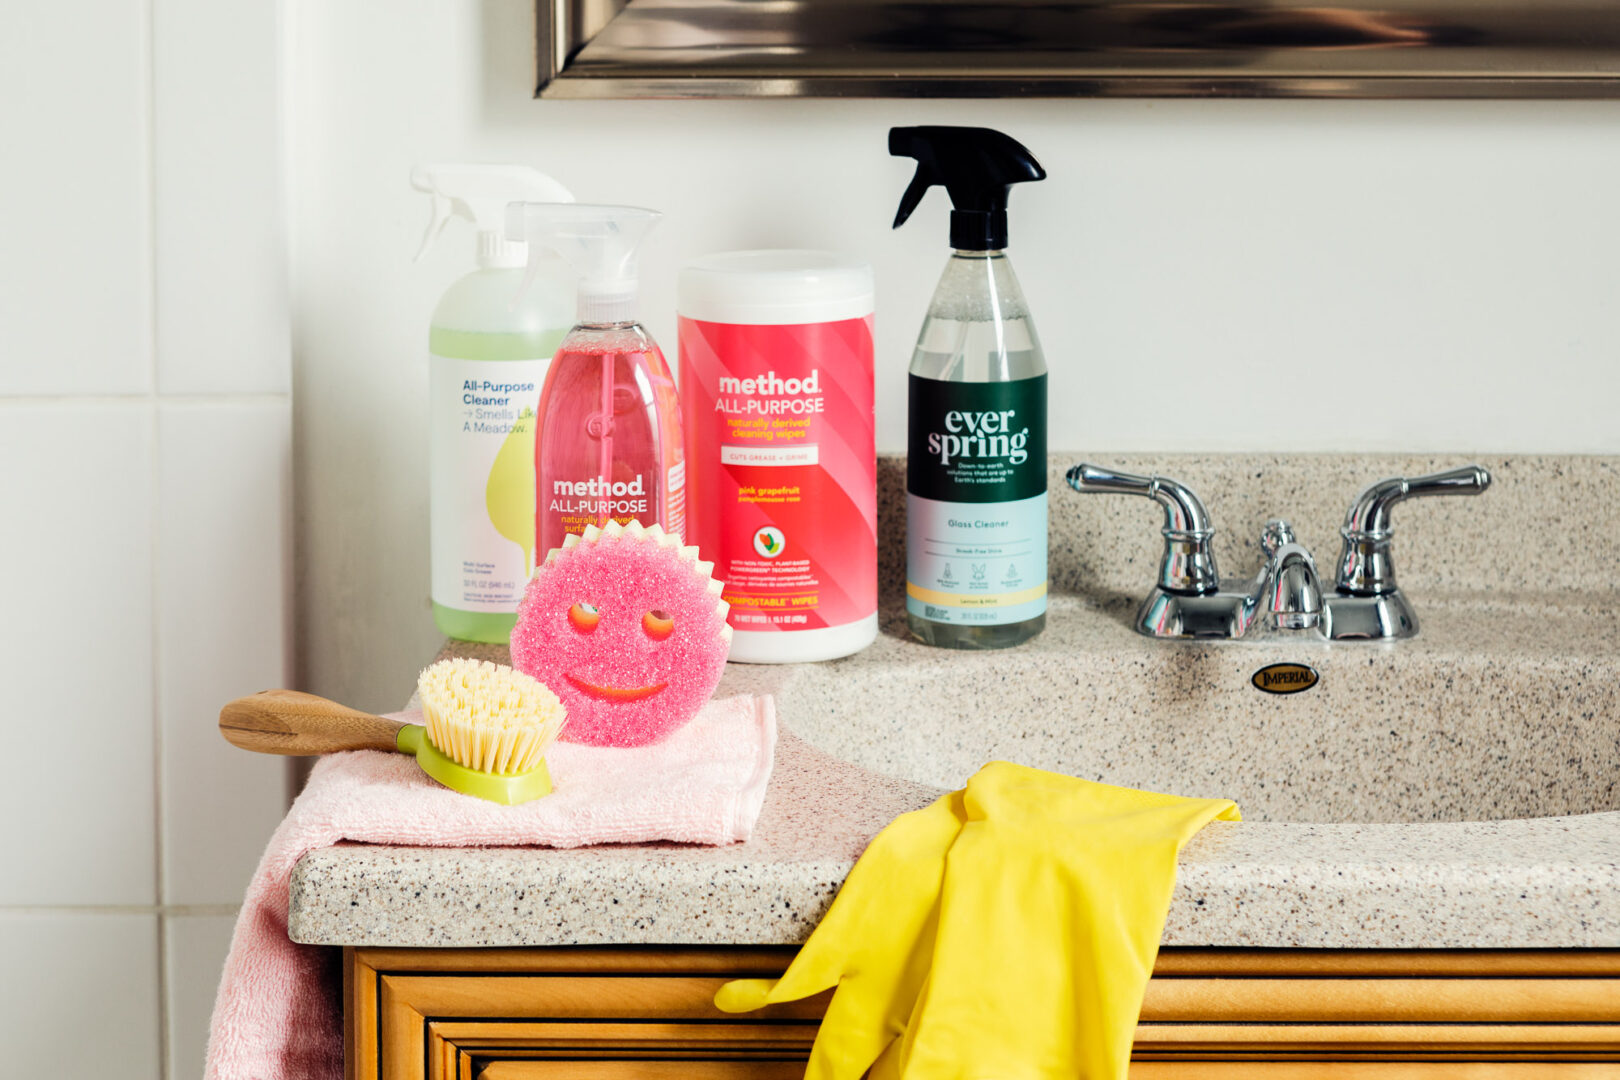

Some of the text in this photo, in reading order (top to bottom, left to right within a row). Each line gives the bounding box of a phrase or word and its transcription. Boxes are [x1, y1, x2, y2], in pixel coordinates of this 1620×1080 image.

[463, 380, 534, 394] All-Purpose
[463, 393, 510, 405] Cleaner
[715, 397, 824, 415] ALL-PURPOSE
[475, 408, 513, 419] Smells
[463, 421, 528, 433] A Meadow.
[728, 416, 810, 430] naturally derived
[945, 409, 1015, 434] ever
[732, 427, 806, 441] cleaning wipes
[928, 427, 1029, 465] spring
[729, 453, 747, 461] CUTS
[750, 453, 776, 461] GREASE
[738, 486, 800, 497] pink grapefruit
[549, 499, 647, 513] ALL-PURPOSE
[561, 515, 598, 525] naturally
[948, 519, 1009, 528] Glass Cleaner
[792, 595, 818, 605] WIPES
[1262, 671, 1311, 686] IMPERIAL
